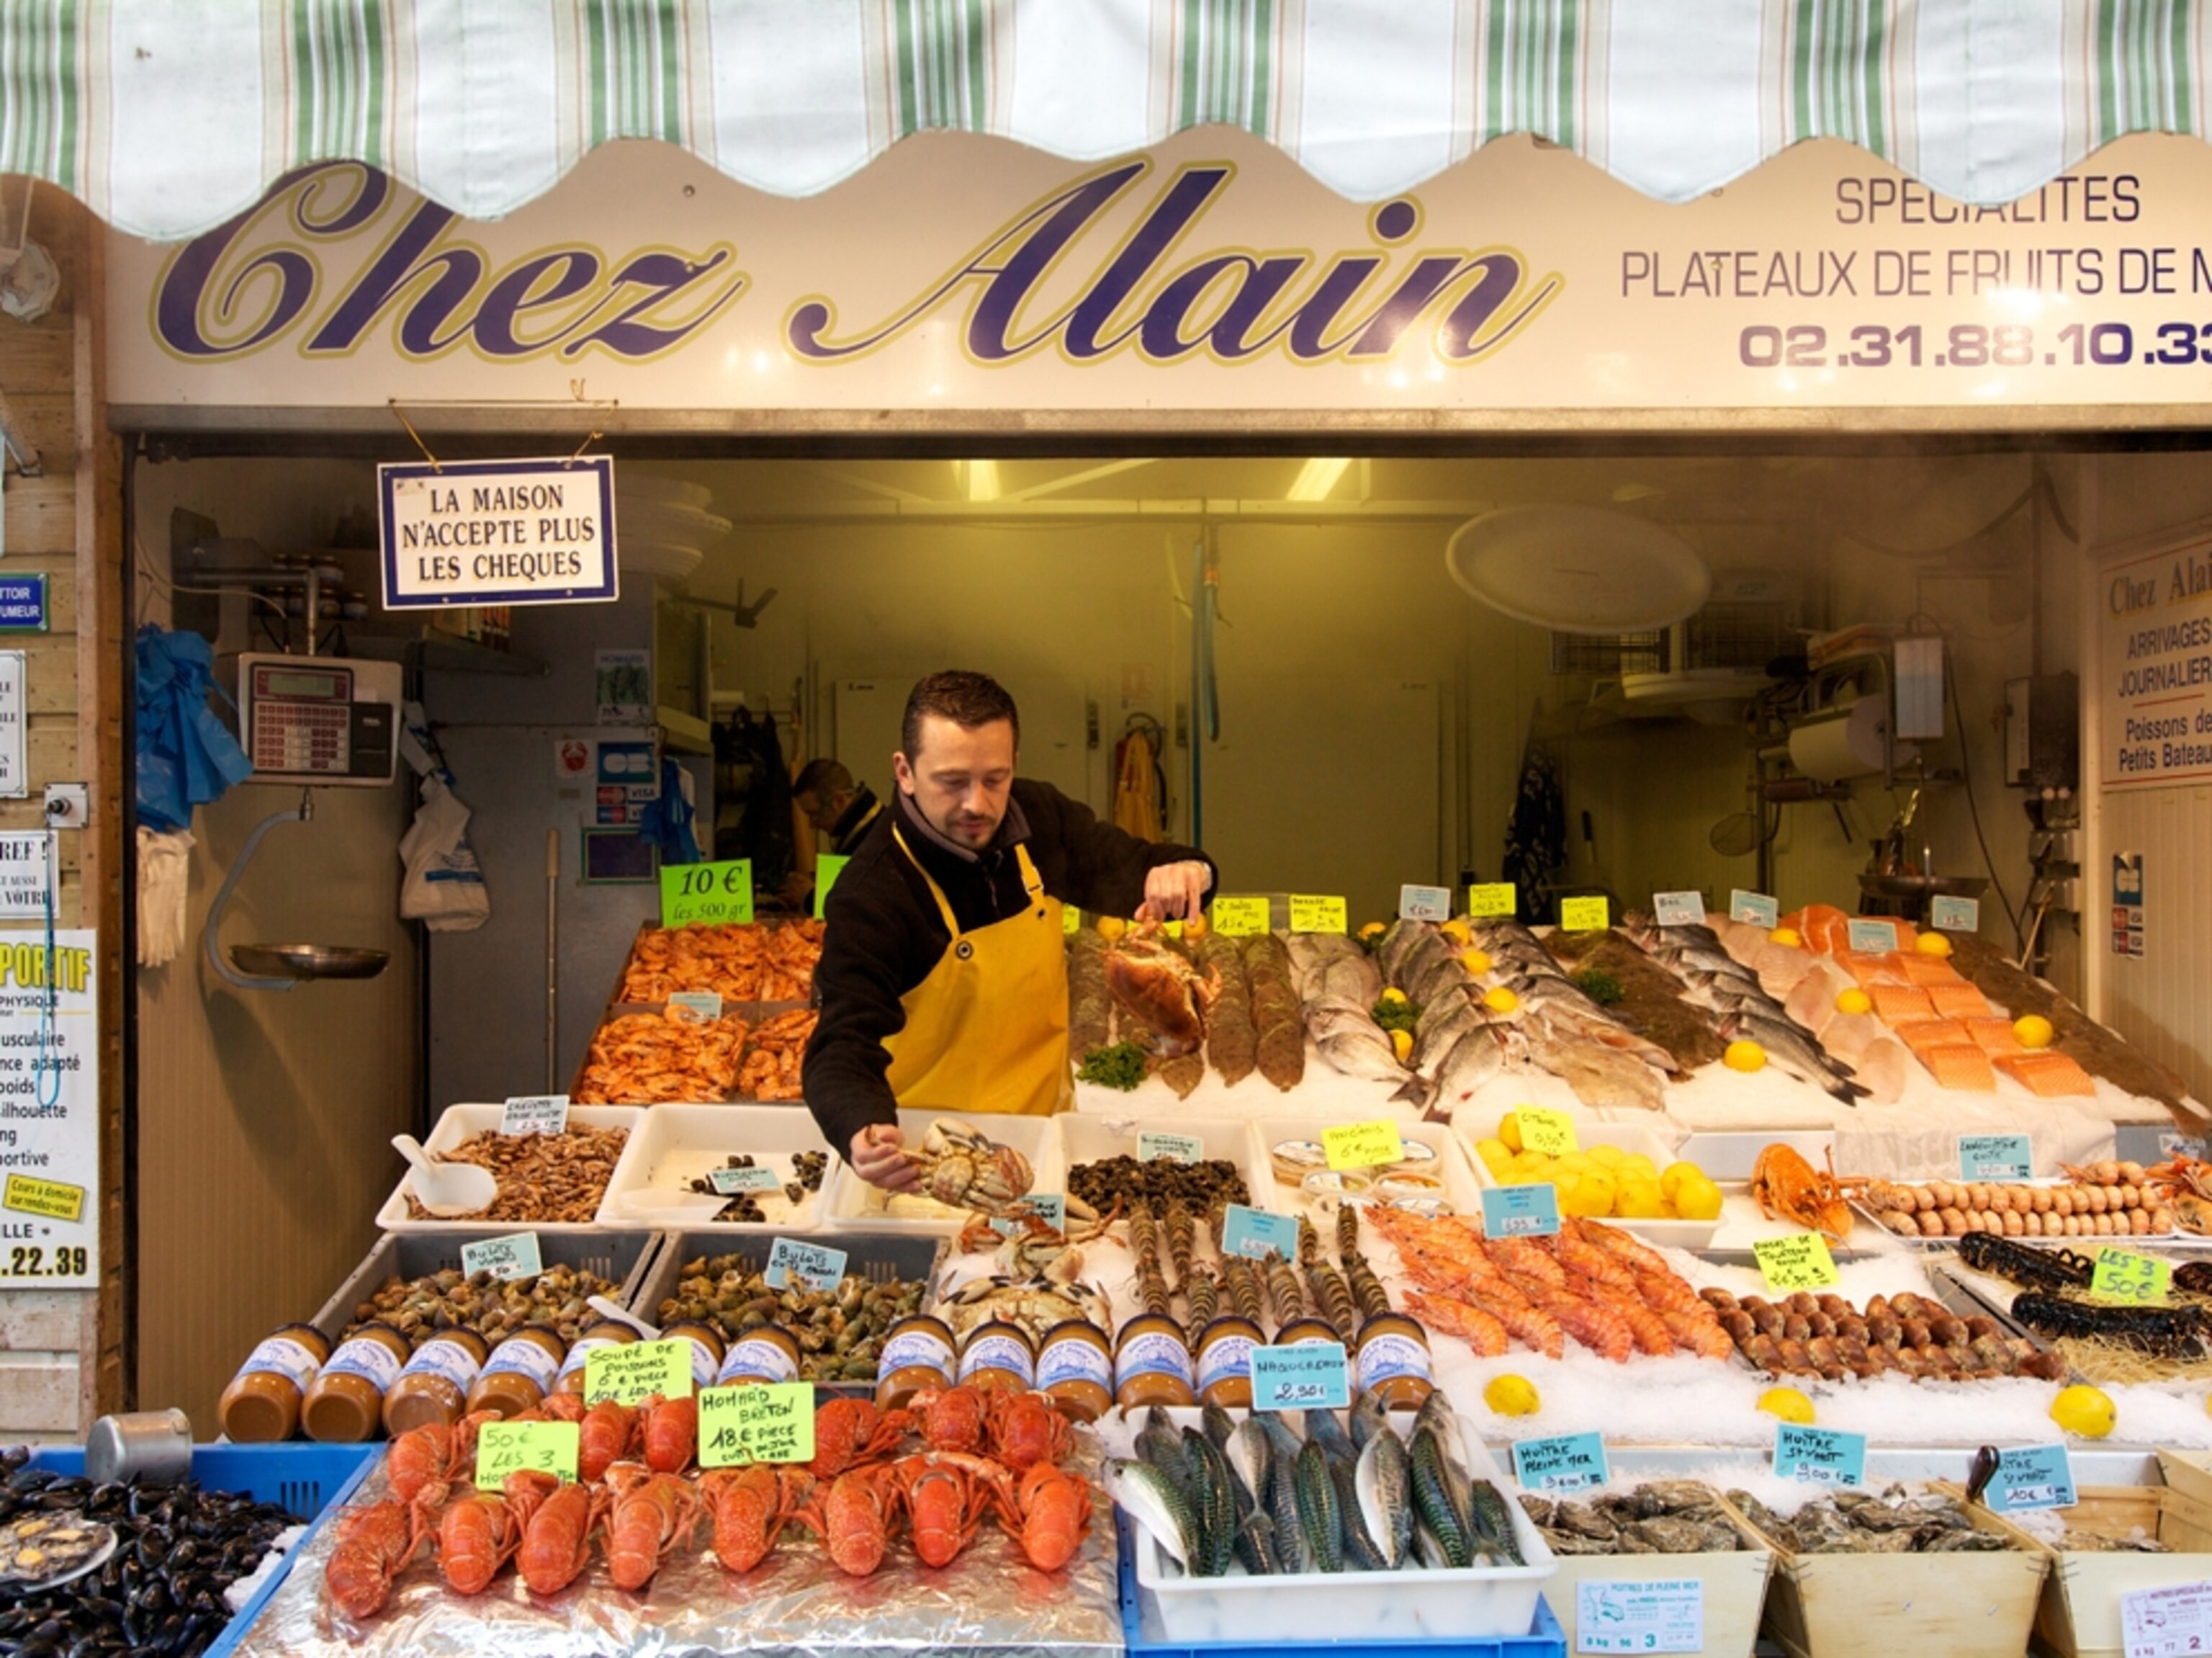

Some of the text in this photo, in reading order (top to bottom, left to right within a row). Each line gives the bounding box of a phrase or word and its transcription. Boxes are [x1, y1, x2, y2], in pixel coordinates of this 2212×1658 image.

[151, 157, 1563, 364] Chez Alain
[1622, 250, 1858, 297] PLATEAUX
[1874, 250, 1931, 297] DE
[1947, 248, 2103, 295] FRUITS
[2118, 248, 2176, 295] DE
[431, 485, 563, 513] LA MAISON
[403, 516, 595, 548] N'ACCEPTE PLUS
[419, 551, 582, 581] LES CHEQUES
[2109, 575, 2157, 616] Chez
[2127, 617, 2211, 660] ARRIVAGES
[2126, 716, 2188, 743] Poissons
[2119, 746, 2157, 772] Petits
[678, 866, 743, 897] 10 €
[673, 902, 747, 920] les 500 gr
[0, 1102, 68, 1118] ilhouette
[1645, 1634, 1656, 1649] 3
[2189, 1635, 2201, 1650] 2
